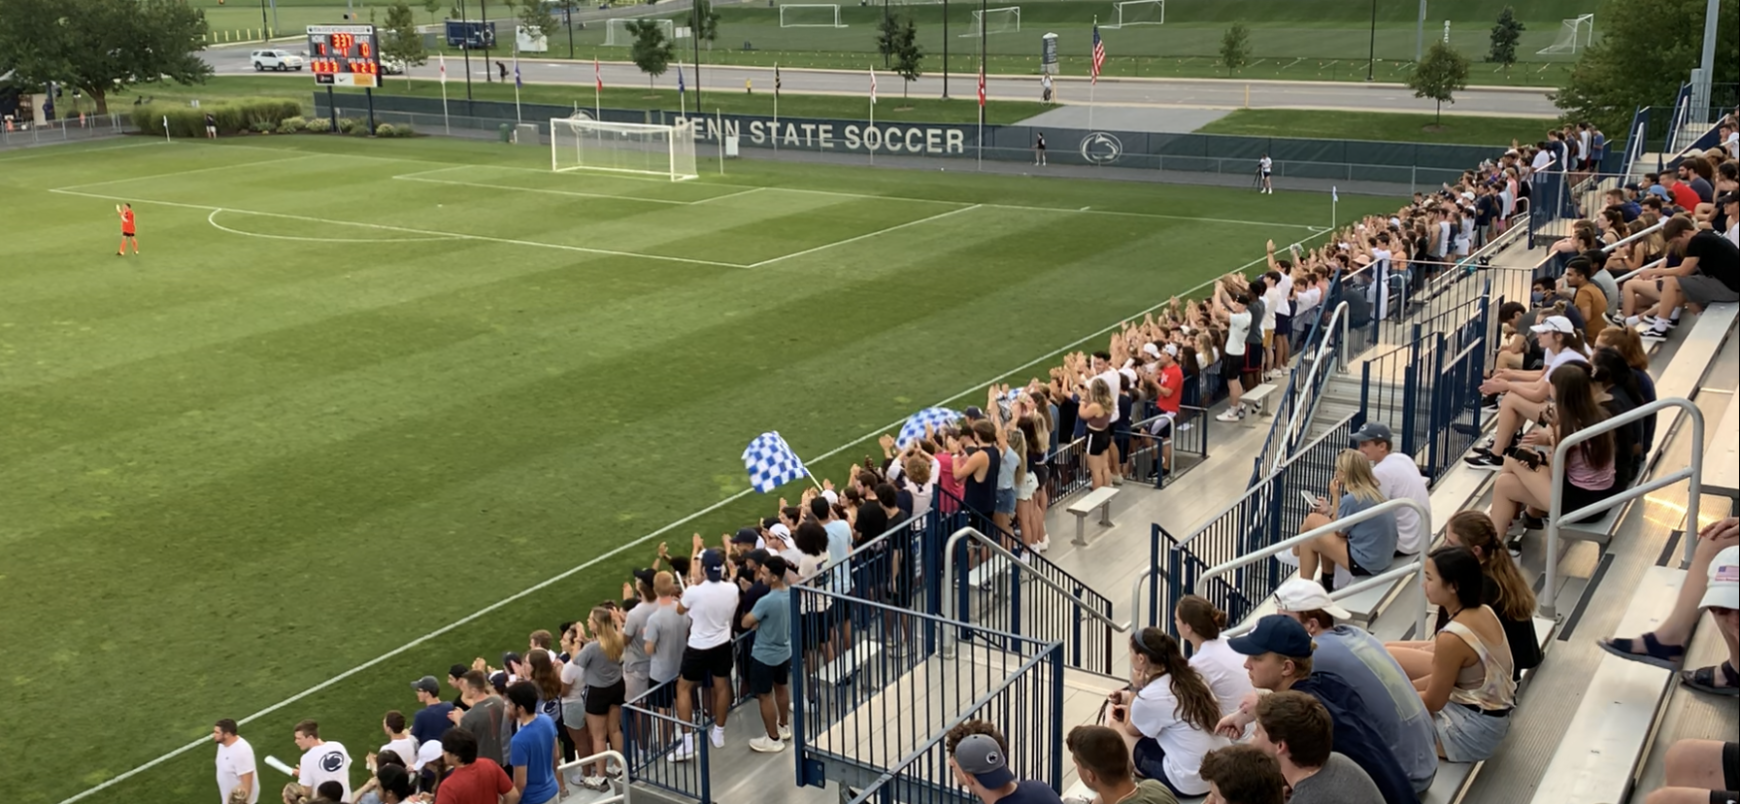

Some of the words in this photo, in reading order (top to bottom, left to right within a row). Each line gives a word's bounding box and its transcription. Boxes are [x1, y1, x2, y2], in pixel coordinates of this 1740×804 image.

[674, 116, 740, 142] PENN
[749, 120, 834, 148] STATE
[844, 124, 964, 154] SOCCER
